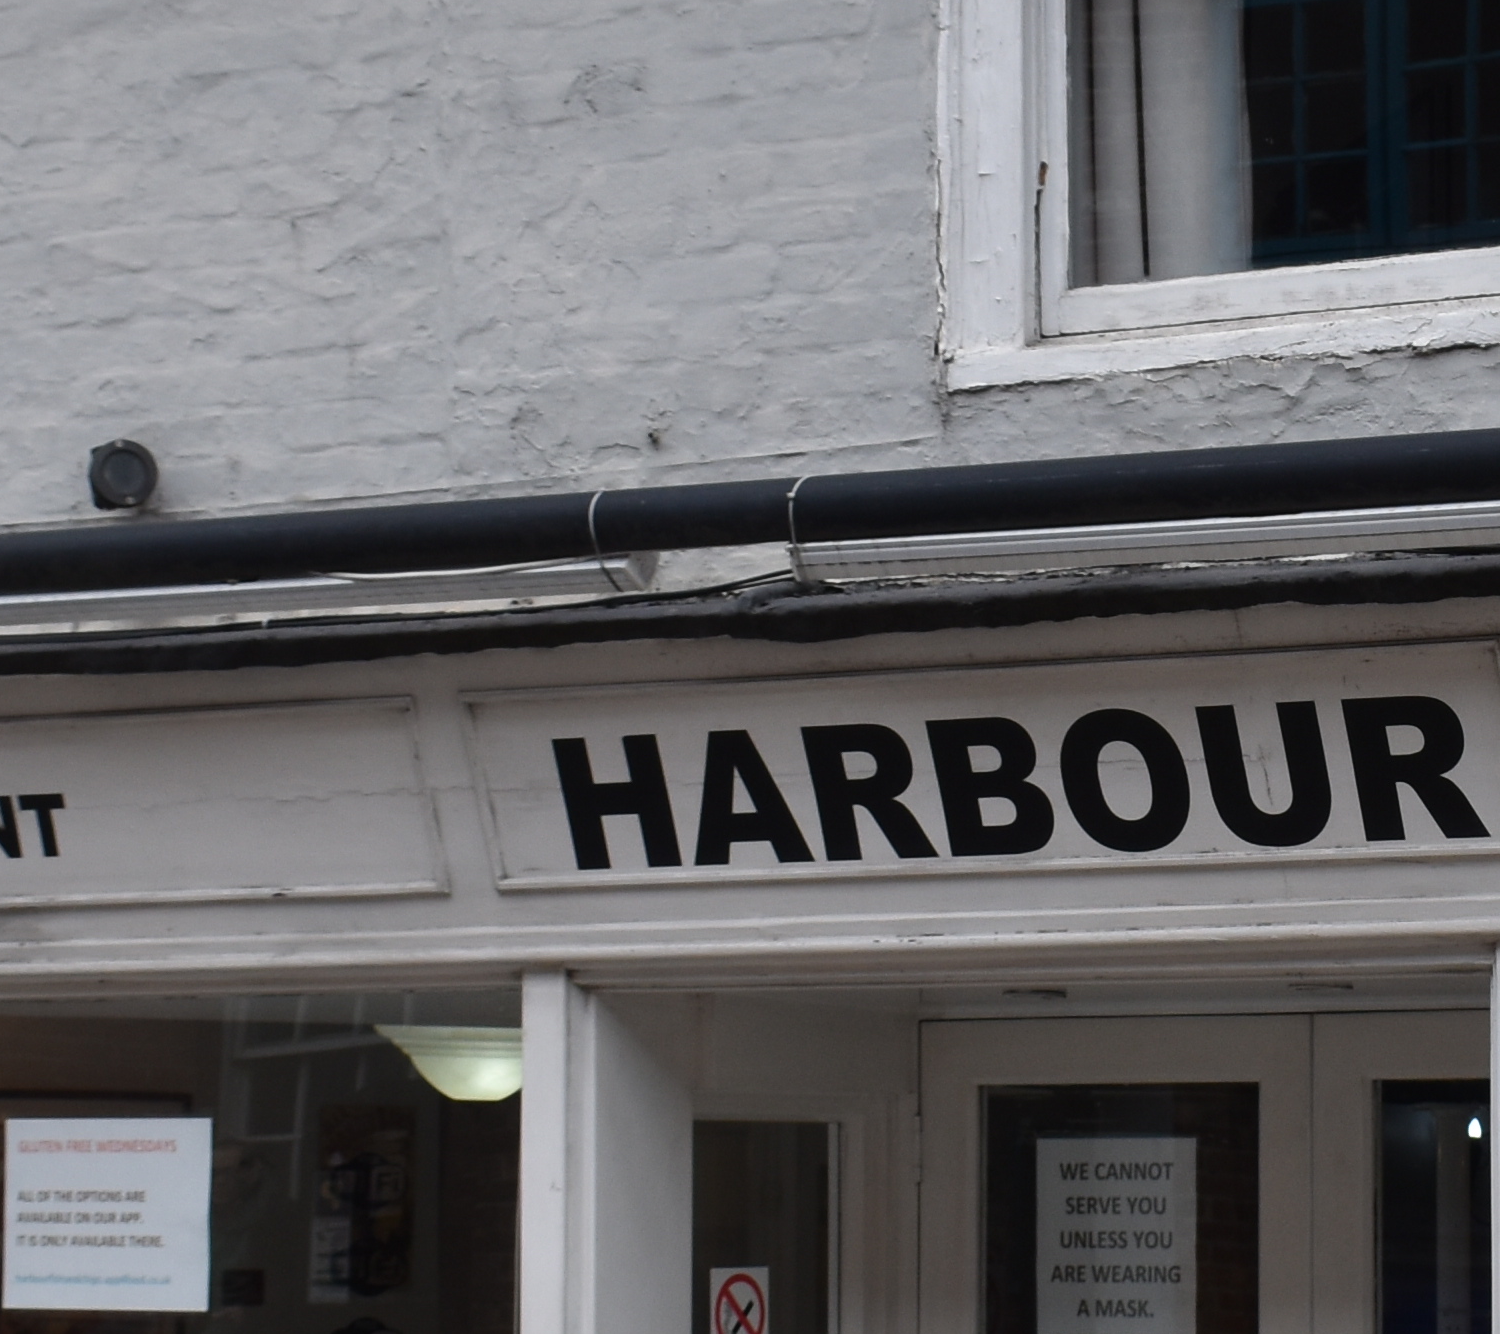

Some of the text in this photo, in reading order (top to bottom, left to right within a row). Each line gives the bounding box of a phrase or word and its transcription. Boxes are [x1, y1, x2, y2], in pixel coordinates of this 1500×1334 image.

[551, 694, 1491, 873] HARBOUR
[19, 1139, 176, 1153] GLUTEN FREE WEDNESDAYS
[1060, 1162, 1173, 1181] WE CANNOT
[17, 1191, 146, 1202] ALL OF THE OPTIONS ARE
[1065, 1197, 1166, 1215] SERVE YOU
[16, 1212, 71, 1223] AVAILABLE
[74, 1212, 90, 1223] ON
[94, 1212, 116, 1223] OUR
[16, 1235, 26, 1246] IT
[28, 1236, 37, 1246] IS
[40, 1236, 68, 1247] ONLY
[70, 1236, 125, 1247] AVAILABLE
[1060, 1231, 1172, 1249] UNLESS YOU
[1051, 1265, 1181, 1284] ARE WEARING
[1077, 1299, 1154, 1318] A MASK.
